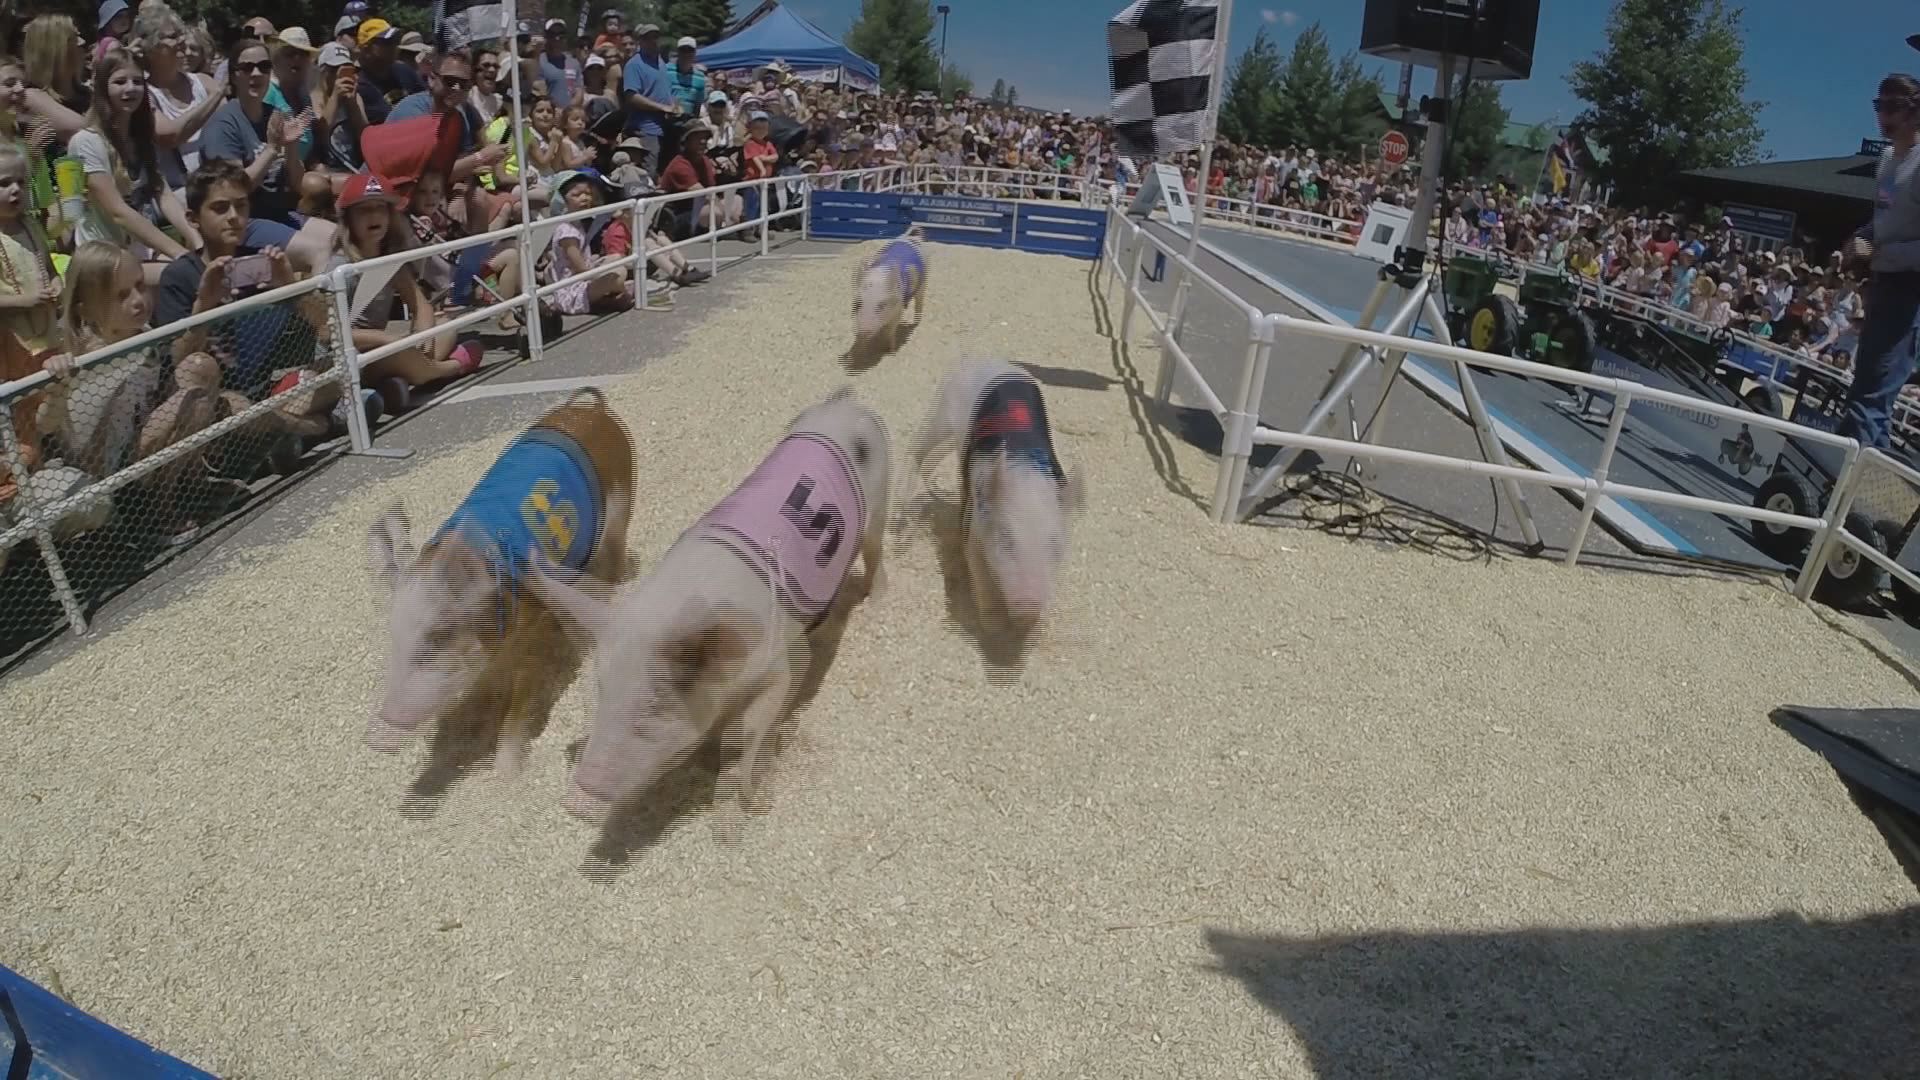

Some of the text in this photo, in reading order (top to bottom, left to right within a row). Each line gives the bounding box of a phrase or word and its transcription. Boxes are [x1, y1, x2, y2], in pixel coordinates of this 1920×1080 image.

[1380, 140, 1406, 155] STOP
[518, 476, 580, 564] 6
[777, 473, 846, 569] 5
